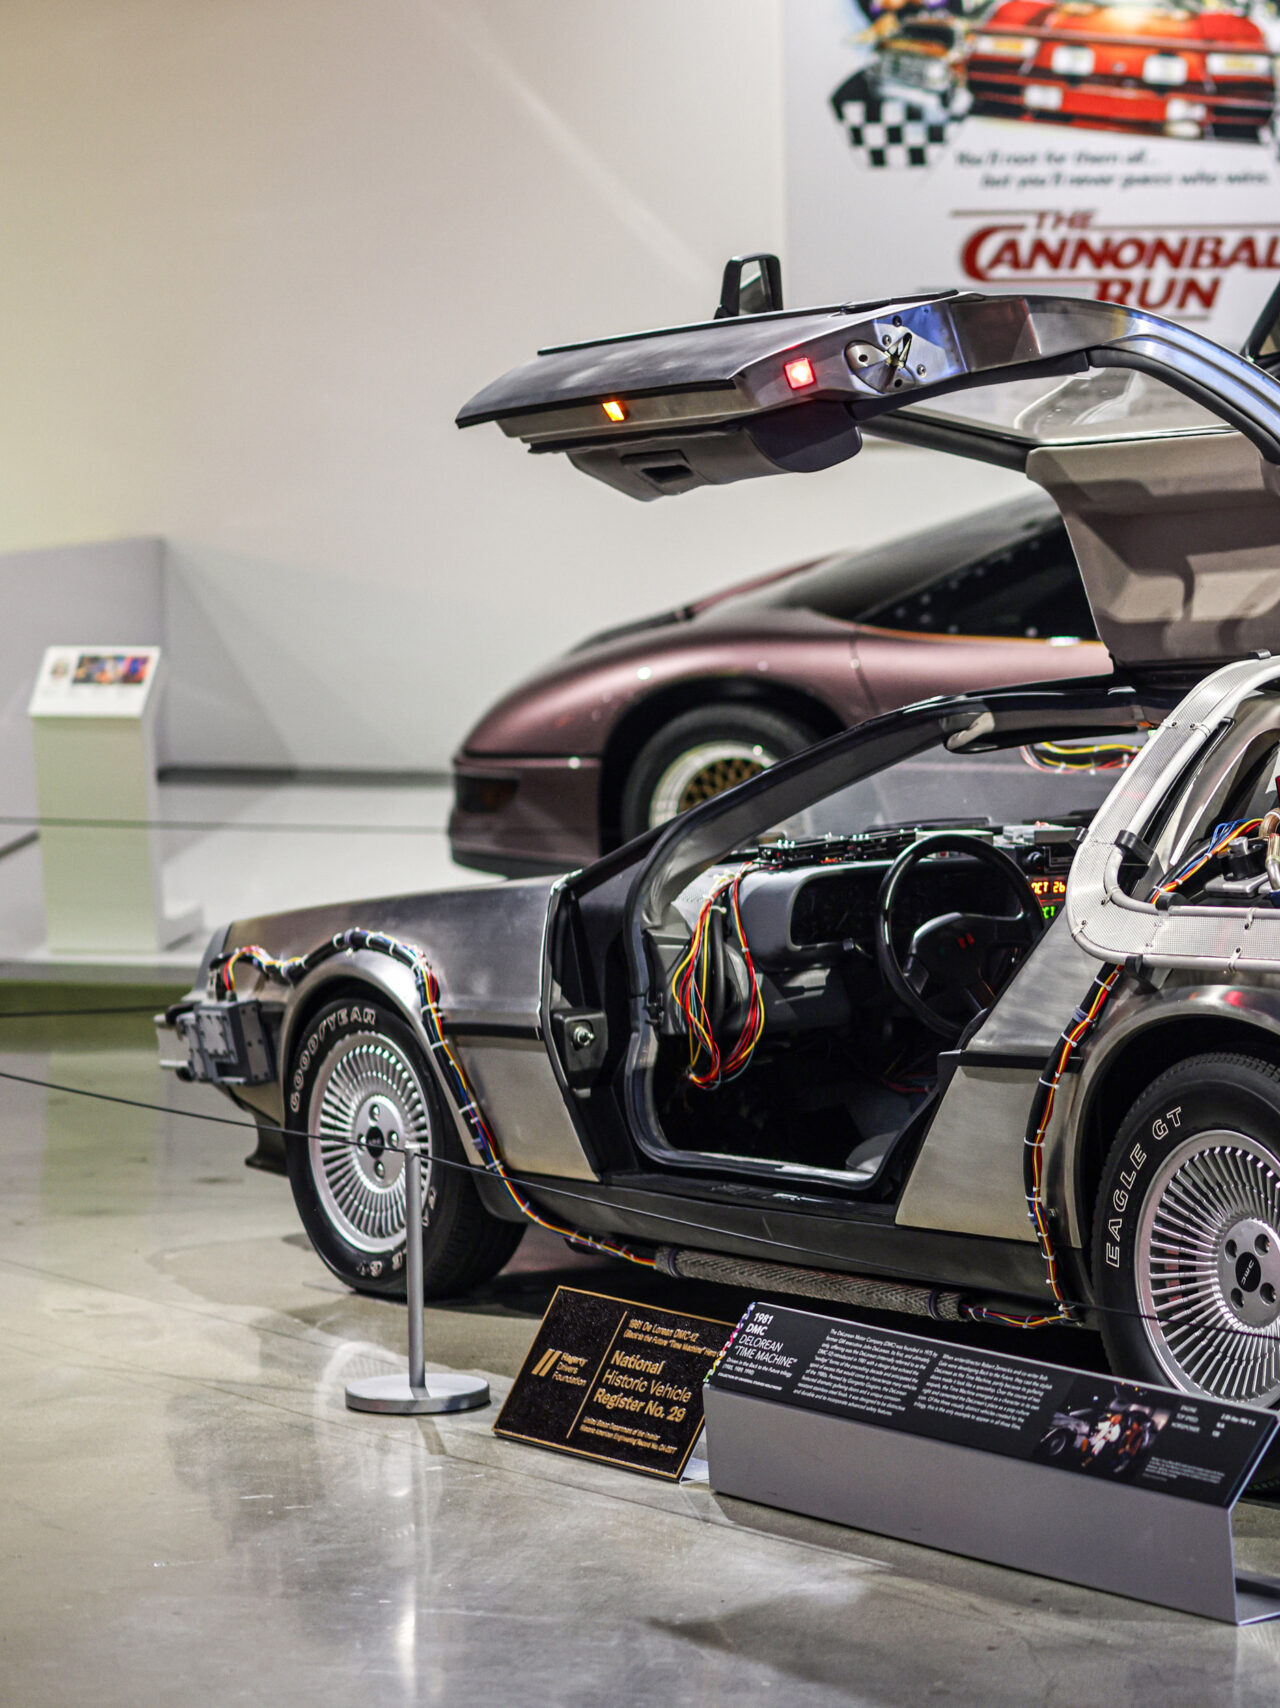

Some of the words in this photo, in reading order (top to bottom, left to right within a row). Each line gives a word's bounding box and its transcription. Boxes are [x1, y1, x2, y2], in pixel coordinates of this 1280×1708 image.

[1036, 210, 1095, 230] THE
[1096, 278, 1221, 310] RUN
[290, 1005, 377, 1113] GOODYEAR
[1106, 1143, 1147, 1268] EAGLE
[1152, 1106, 1183, 1141] GT
[753, 1312, 773, 1324] 1981
[745, 1323, 768, 1335] DMC
[738, 1334, 783, 1352] DELOREAN
[560, 1352, 588, 1367] Hagerty
[609, 1349, 665, 1376] National
[734, 1345, 756, 1359] "TIME
[754, 1350, 797, 1367] MACHINE"
[556, 1361, 579, 1375] Drivers
[552, 1371, 587, 1387] Foundation
[601, 1368, 649, 1394] Historic
[649, 1381, 692, 1403] Vehicle
[593, 1387, 646, 1413] Register
[643, 1401, 665, 1419] No.
[666, 1406, 687, 1423] 29
